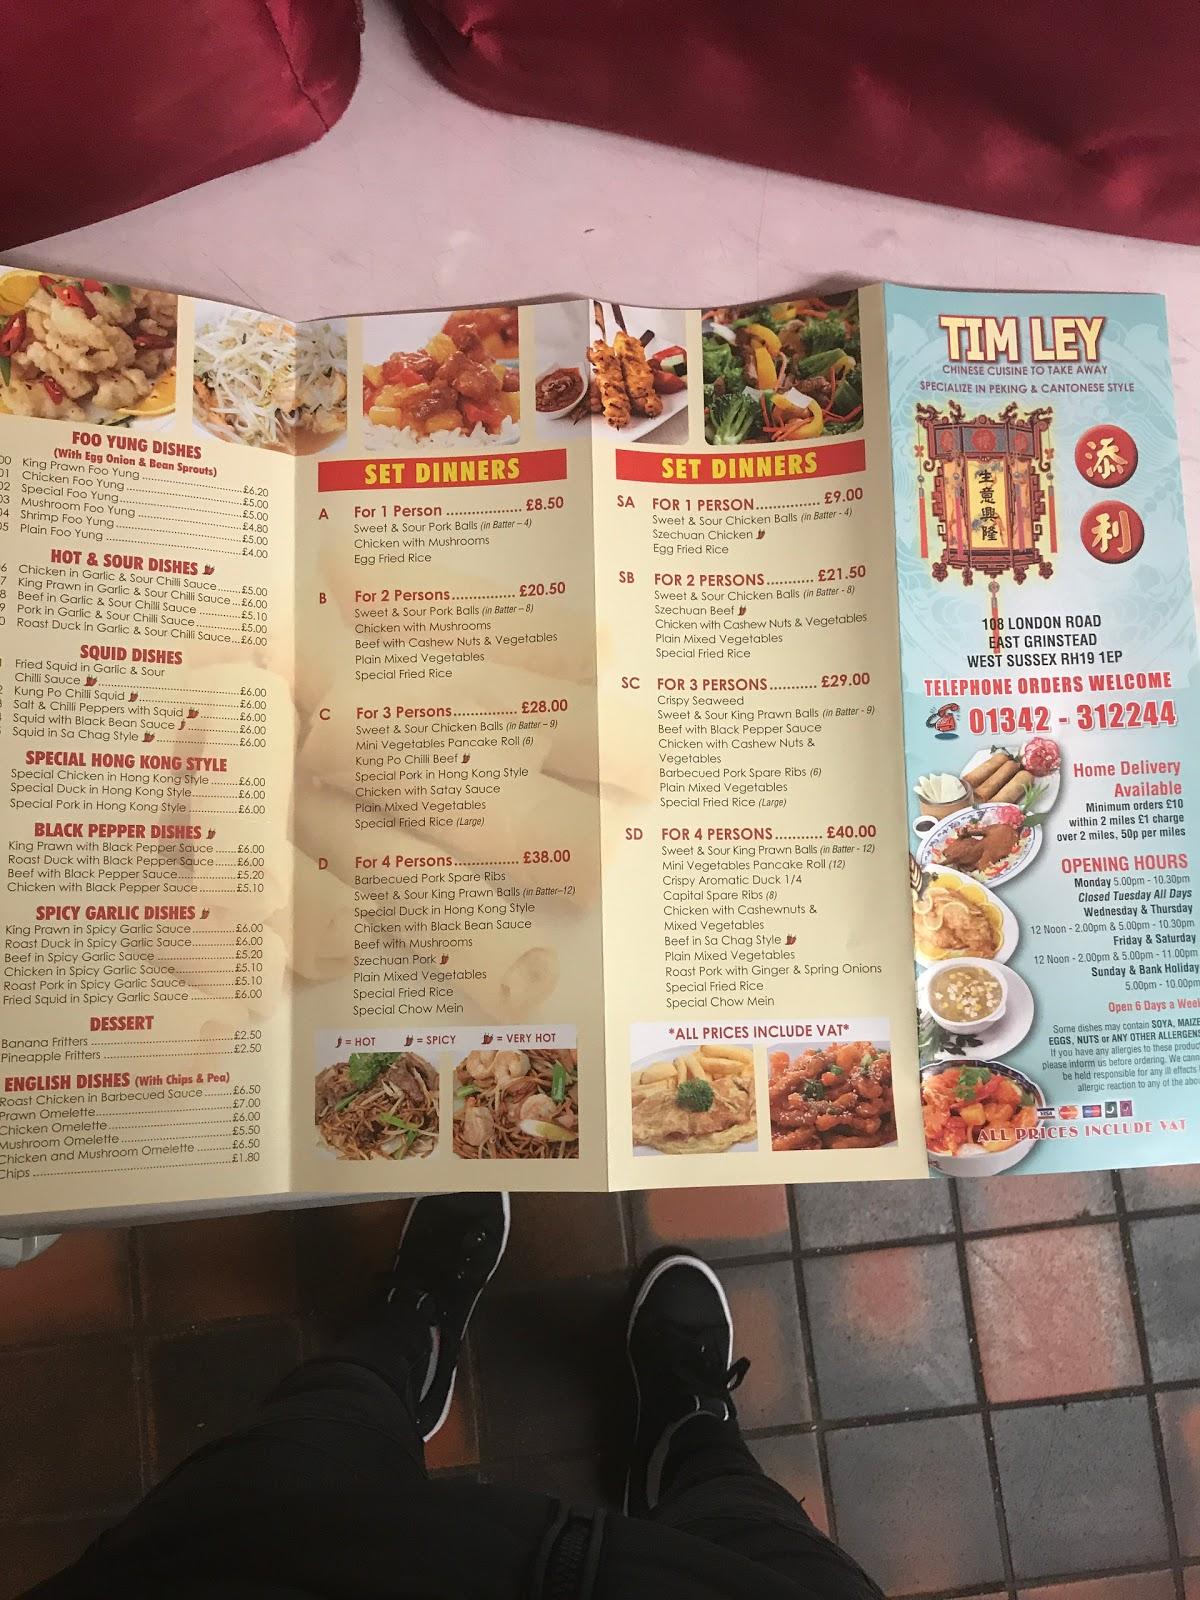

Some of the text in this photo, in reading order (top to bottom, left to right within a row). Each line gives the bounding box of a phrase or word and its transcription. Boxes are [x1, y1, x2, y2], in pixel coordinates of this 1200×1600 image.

[939, 314, 1106, 362] TIM LEY
[942, 365, 1108, 375] CHINESE CUISINE TO TAKE AWAY
[920, 382, 1134, 393] SPECIALIZE IN PEKING & CANTONESE STYLE
[72, 431, 202, 459] FOO YUNG DISHES
[54, 448, 217, 477] (With Egg Onion & Bean Sprouts)
[661, 452, 817, 479] SET DINNERS
[1086, 438, 1128, 479] 添
[365, 458, 520, 485] SET DINNERS
[617, 496, 635, 508] SA
[653, 499, 679, 510] FOR
[698, 499, 754, 511] PERSON
[824, 488, 863, 504] £9.00
[319, 508, 329, 520] A
[355, 506, 376, 518] For
[394, 505, 442, 516] Person
[526, 497, 564, 511] £8.50
[354, 523, 387, 533] Sweet
[391, 523, 398, 532] &
[402, 522, 425, 532] Sour
[429, 521, 451, 531] Pork
[455, 520, 477, 530] Balls
[493, 520, 514, 529] Batter
[653, 530, 753, 539] Szechuan Chicken
[1092, 511, 1131, 554] 利
[354, 537, 489, 549] Chicken with Mushrooms
[51, 549, 198, 575] HOT & SOUR DISHES
[354, 553, 431, 565] Egg Fried Rice
[982, 615, 1101, 630] 108 LONDON ROAD
[989, 634, 1097, 648] EAST GRINSTEAD
[80, 645, 182, 665] SQUID DISHES
[967, 651, 1123, 667] WEST SUSSEX RH19 1EP
[15, 659, 165, 676] Fried Squid in Garlic & Sour
[925, 672, 1172, 696] TELEPHONE ORDERS WELCOME
[969, 706, 1050, 734] 01342
[1076, 700, 1176, 731] 312244
[26, 751, 227, 772] SPECIAL HONG KONG STYLE
[1073, 760, 1181, 777] Home Delivery
[1115, 781, 1182, 797] Available
[1086, 799, 1184, 812] Minimum orders £10
[34, 823, 202, 839] BLACK PEPPER DISHES
[625, 825, 876, 840] SD FOR 4 PERSONS £40.00
[1062, 854, 1188, 873] OPENING HOURS
[8, 869, 264, 880] Beef with Black Pepper Sauce £5.20
[1074, 877, 1111, 888] Monday
[1114, 876, 1144, 886] 5.00pm
[1154, 875, 1190, 885] 10.30pm
[663, 890, 777, 901] Capital Spare Ribs (8)
[1078, 888, 1192, 902] Closed Tuesday All Days
[36, 906, 195, 921] SPICY GARLIC DISHES
[1084, 903, 1193, 918] Wednesday & Thursday
[353, 1003, 464, 1016] Special Chow Mein
[90, 1015, 154, 1031] DESSERT
[2, 1030, 262, 1048] Banana Fritters £2.50
[426, 1035, 456, 1045] SPICY
[506, 1033, 556, 1043] VERY HOT
[703, 1026, 749, 1039] PRICES
[753, 1025, 812, 1038] INCLUDE
[1077, 1035, 1099, 1044] NUTS
[1112, 1033, 1127, 1042] ANY
[1130, 1032, 1156, 1041] OTHER
[355, 1037, 375, 1046] HOT
[5, 1072, 230, 1092] ENGLISH DISHES (With Chips & Pea)
[977, 1120, 1186, 1142] ALL PRICES INCLUDE VAT
